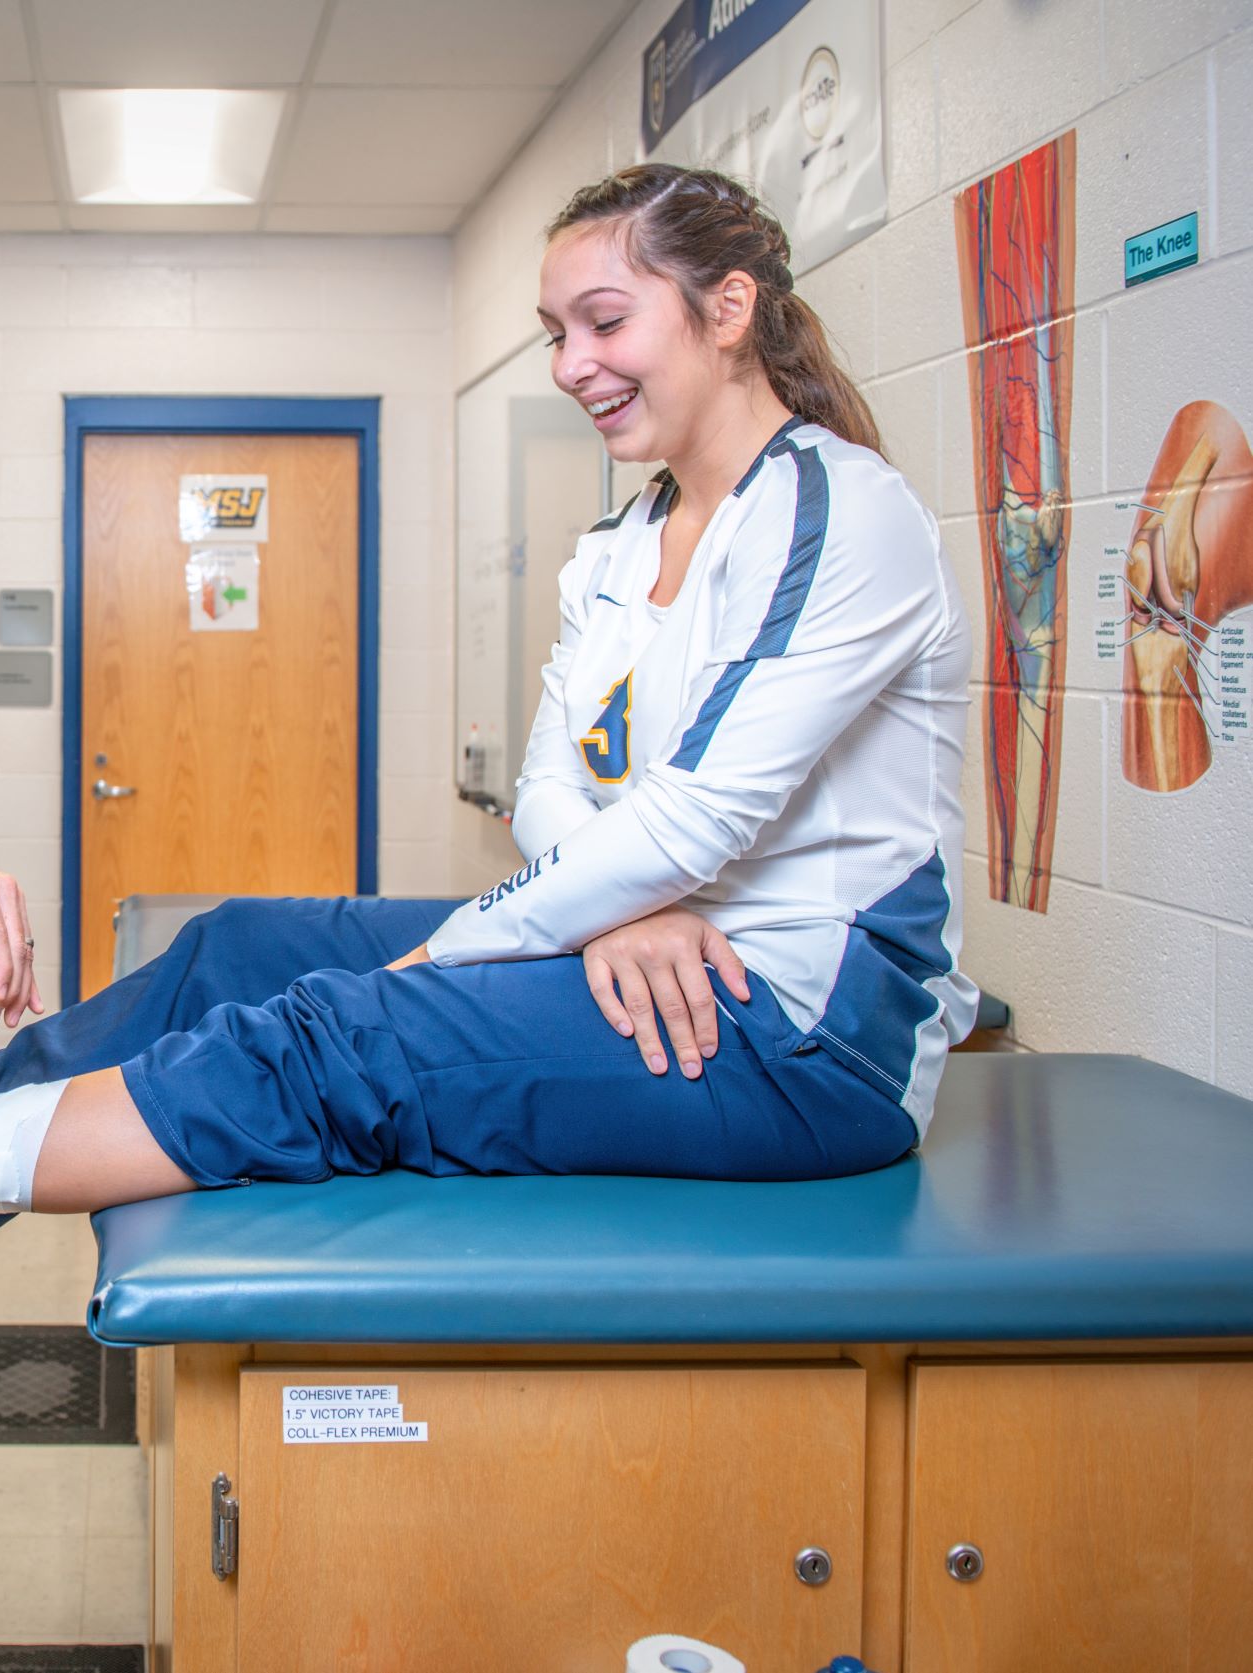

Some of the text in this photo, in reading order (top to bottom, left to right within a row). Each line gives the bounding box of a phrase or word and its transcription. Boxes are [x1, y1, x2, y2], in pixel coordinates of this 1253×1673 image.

[1129, 231, 1192, 267] The Knee
[1221, 637, 1244, 646] cartilage
[1221, 650, 1245, 659] Posterior
[1221, 661, 1244, 669] ligament
[1221, 675, 1239, 684] Medial
[1222, 700, 1240, 708] Medial
[1222, 710, 1246, 718] collateral
[1222, 719, 1247, 728] ligaments
[1221, 732, 1234, 741] Tibia
[478, 842, 560, 913] LIONS
[289, 1389, 391, 1401] COHESIVE TAPE:
[286, 1407, 400, 1420] 1.5" VICTORY TAPE
[287, 1426, 419, 1439] COLL-FLEX PREMIUM
